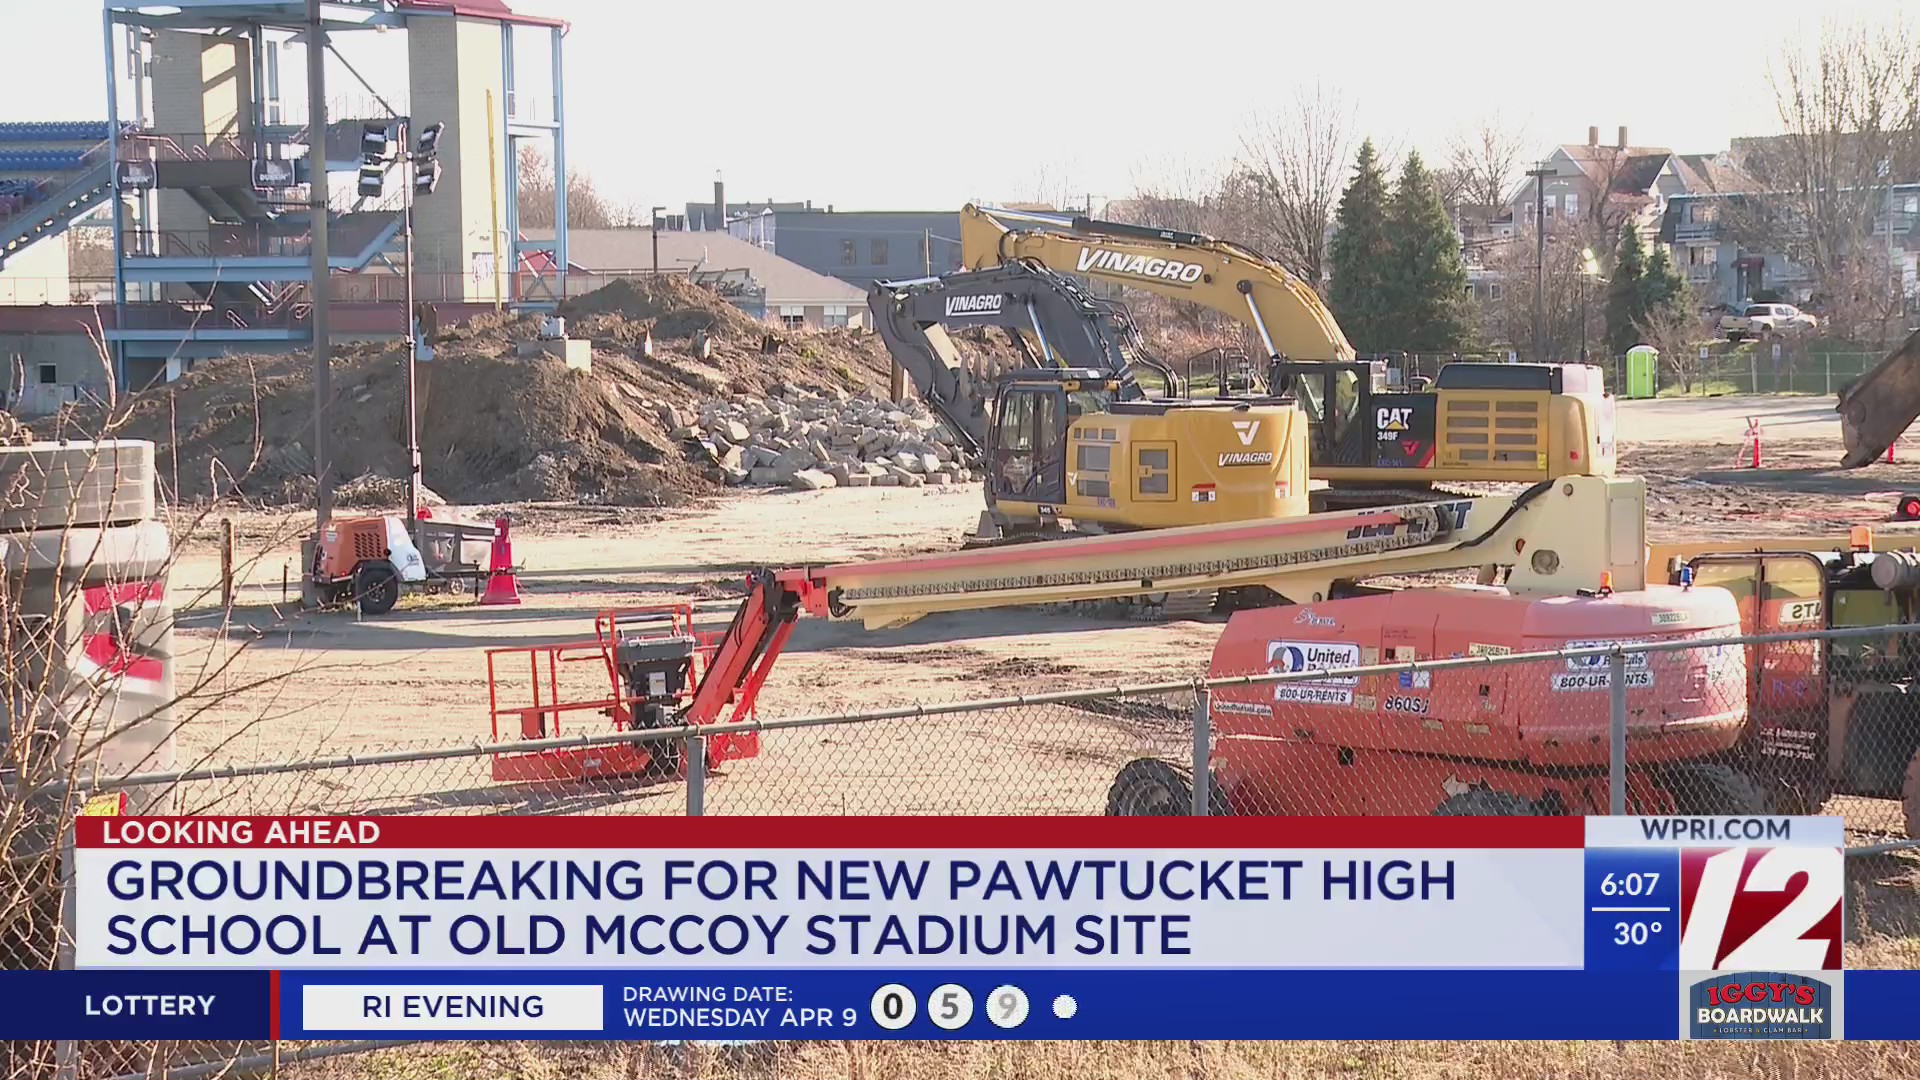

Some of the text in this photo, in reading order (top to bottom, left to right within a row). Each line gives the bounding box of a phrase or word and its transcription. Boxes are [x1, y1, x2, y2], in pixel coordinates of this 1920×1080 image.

[1075, 247, 1204, 283] VINAGRO
[945, 294, 1002, 316] VINAGRO
[1377, 408, 1412, 430] CAT
[1377, 431, 1399, 441] 349F
[1218, 452, 1273, 467] VINAGRO
[1307, 648, 1351, 664] United
[1385, 696, 1429, 713] 860SJ
